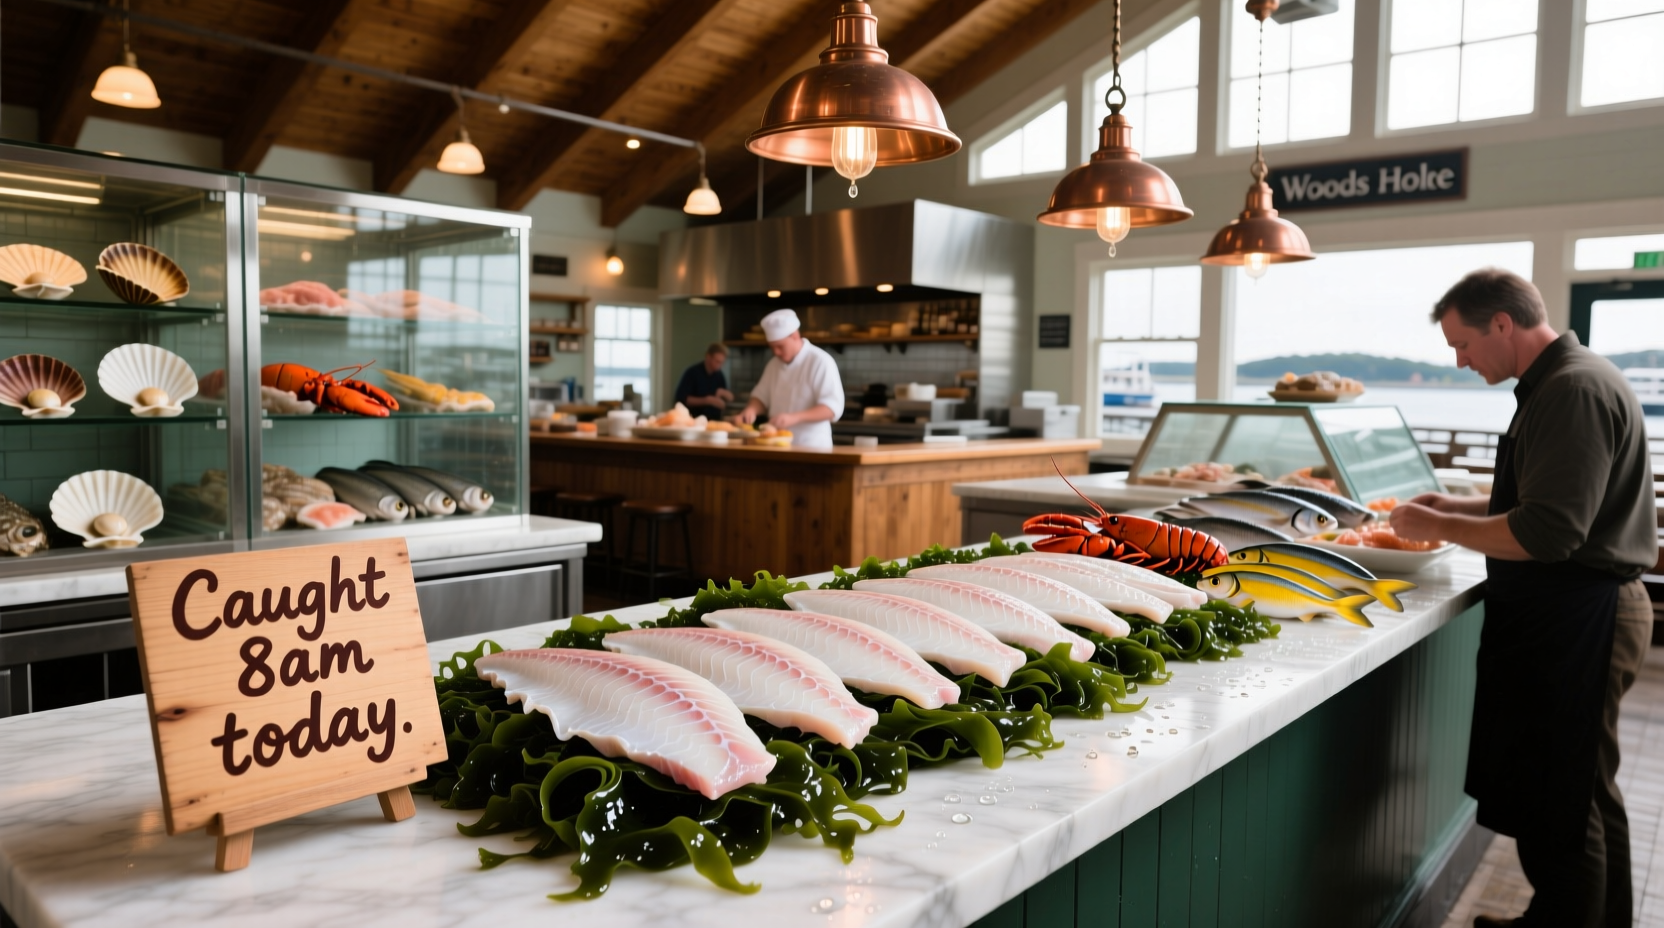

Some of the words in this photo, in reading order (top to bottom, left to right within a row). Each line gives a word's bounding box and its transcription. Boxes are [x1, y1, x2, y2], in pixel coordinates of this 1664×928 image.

[1281, 169, 1370, 202] Woods
[171, 555, 391, 641] Caught
[237, 635, 375, 697] 8am
[211, 690, 413, 776] today.
